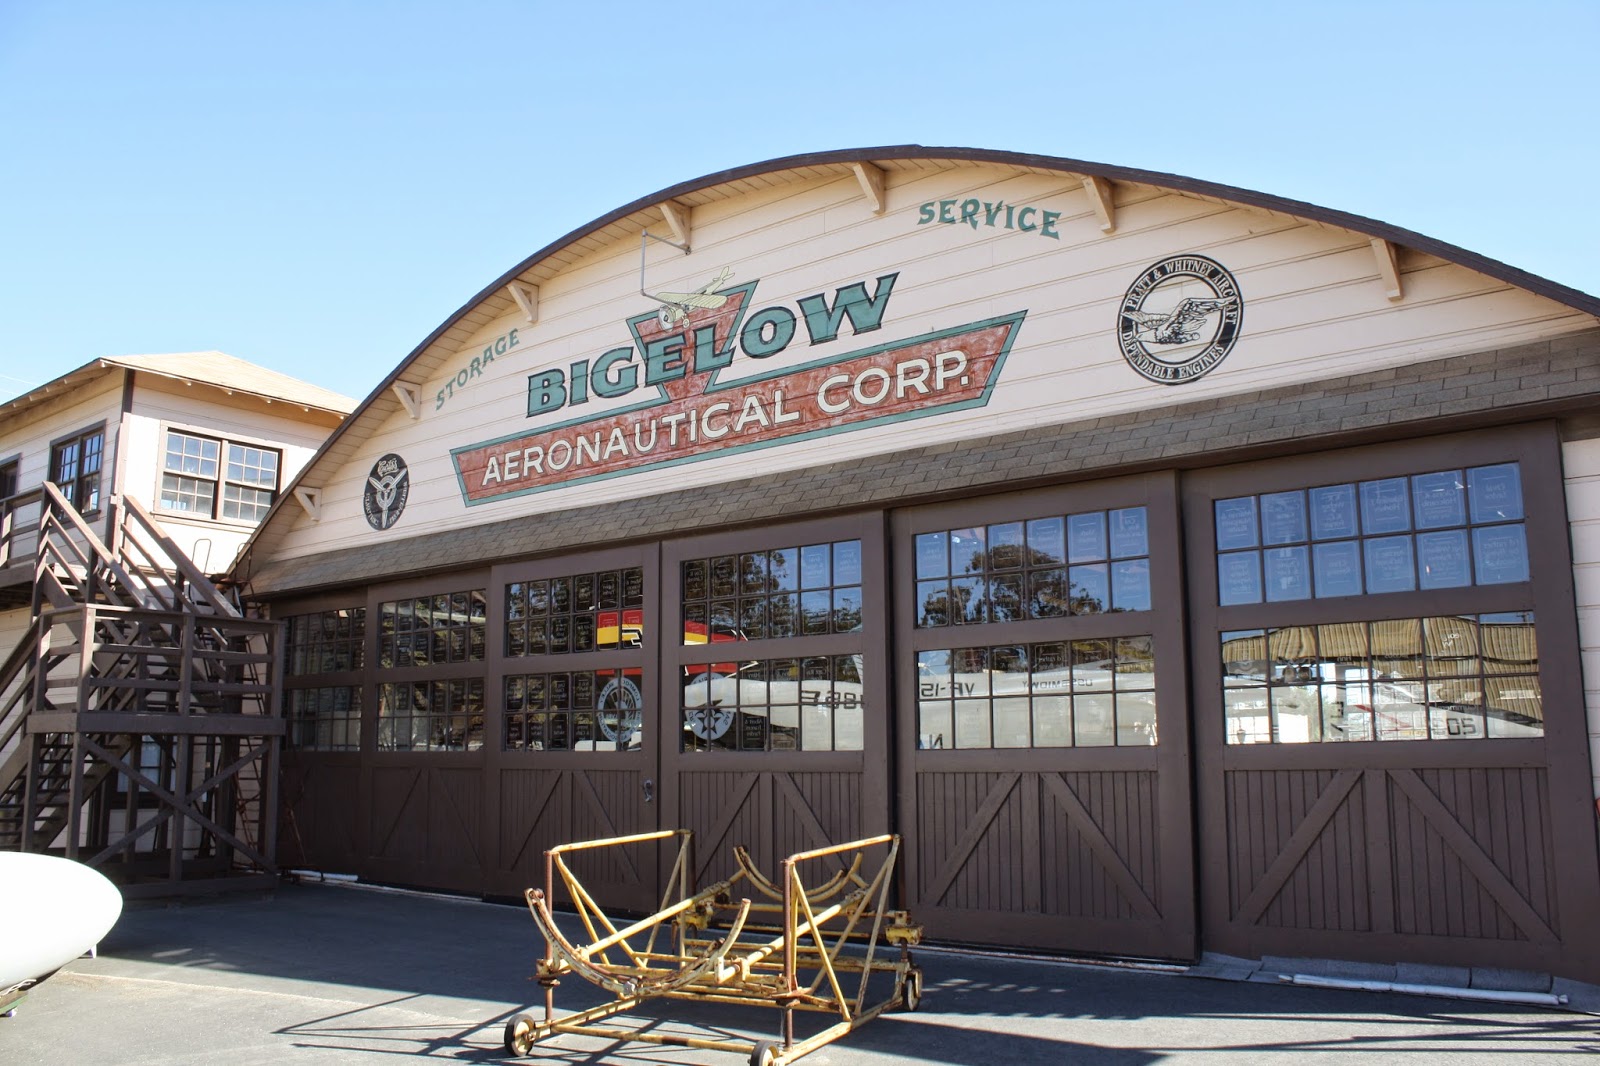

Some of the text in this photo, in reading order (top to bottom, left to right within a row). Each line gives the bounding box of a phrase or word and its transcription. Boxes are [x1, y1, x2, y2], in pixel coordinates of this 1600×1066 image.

[917, 198, 1062, 240] SERVICE
[1127, 259, 1238, 325] PRATT & WHITNEY AIRCAFT
[435, 328, 520, 412] STORAGE
[526, 271, 901, 419] BIGELOW
[1122, 330, 1225, 379] DEPENDABLE ENGINES
[481, 350, 970, 487] AERONAUTICAL CORP.
